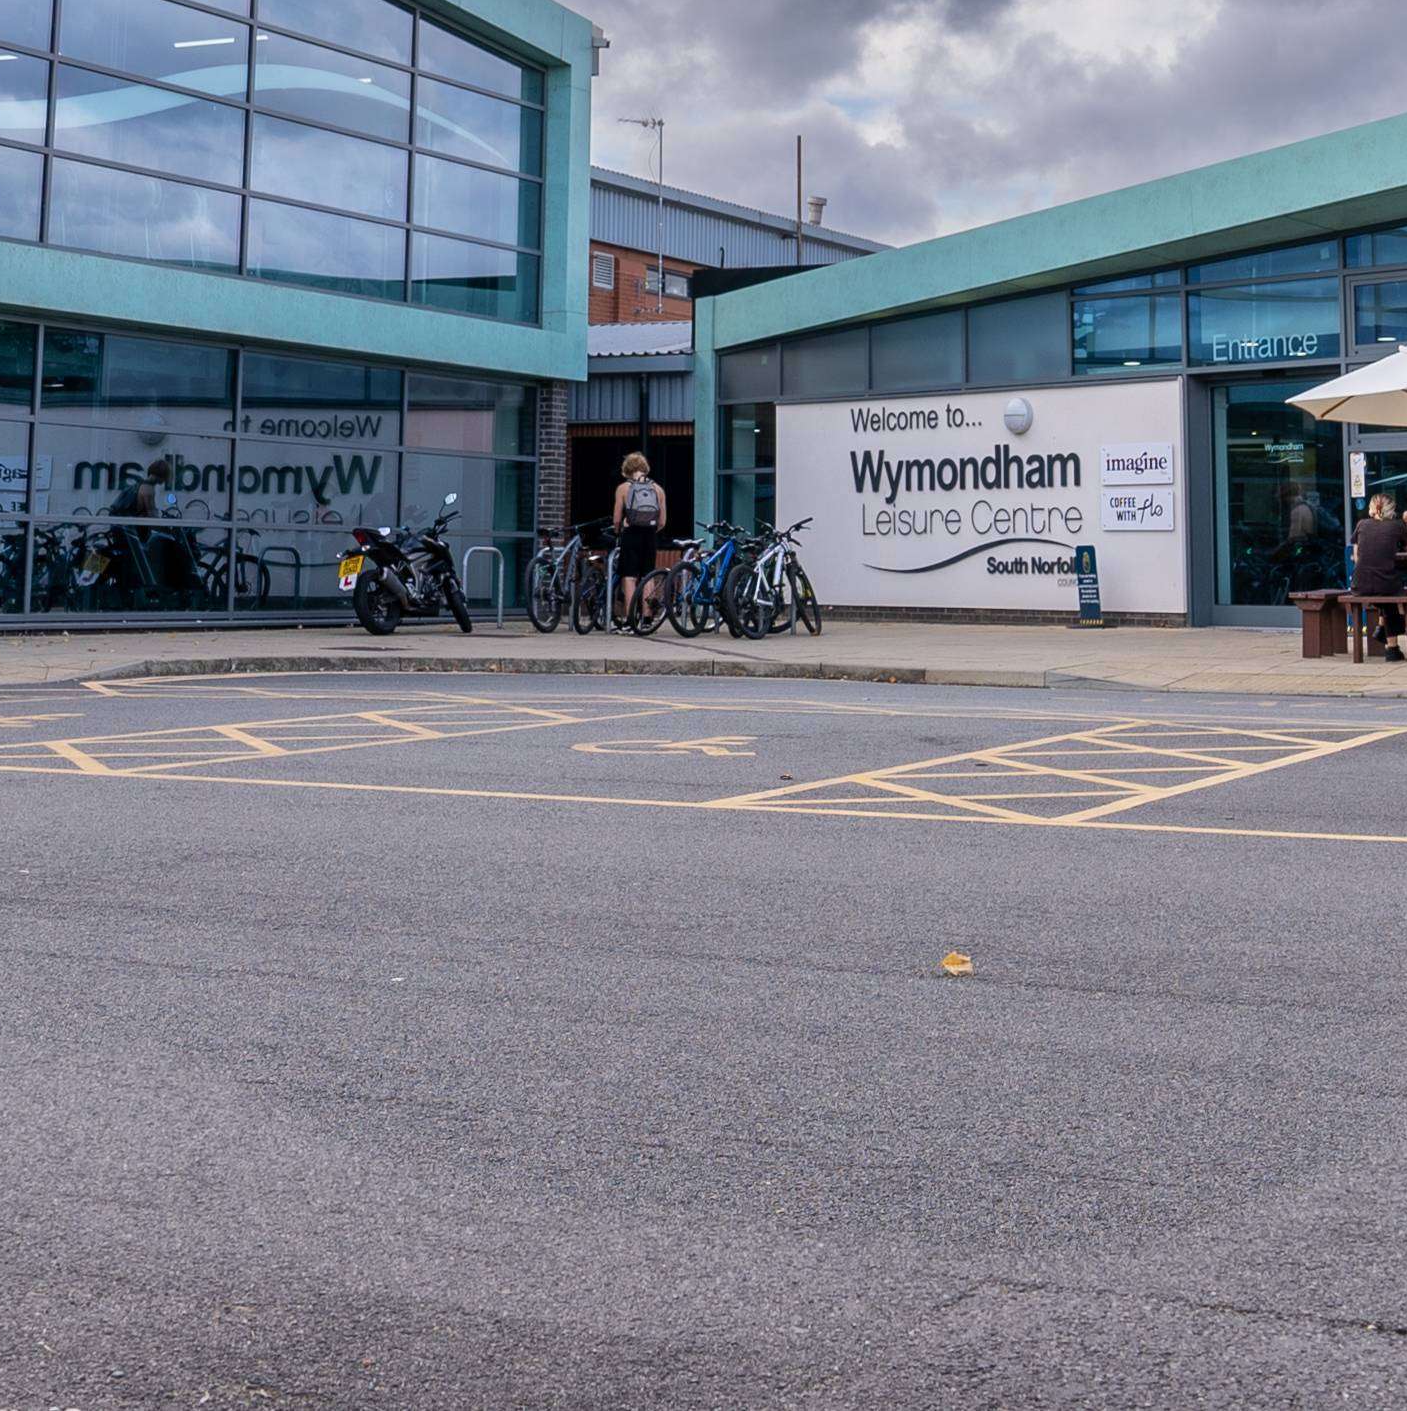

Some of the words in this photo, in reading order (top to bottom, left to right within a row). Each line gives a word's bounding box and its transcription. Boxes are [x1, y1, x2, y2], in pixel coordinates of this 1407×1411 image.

[1212, 333, 1318, 362] Entrance
[851, 406, 939, 433] Welcome
[850, 444, 1081, 505] Wymondham
[1106, 452, 1168, 475] imagine
[1109, 496, 1137, 508] COFFEE
[862, 502, 962, 536] Leisure
[971, 500, 1083, 535] Centre
[1116, 510, 1137, 521] WITH
[986, 556, 1029, 575] South
[1031, 556, 1077, 575] Norfol
